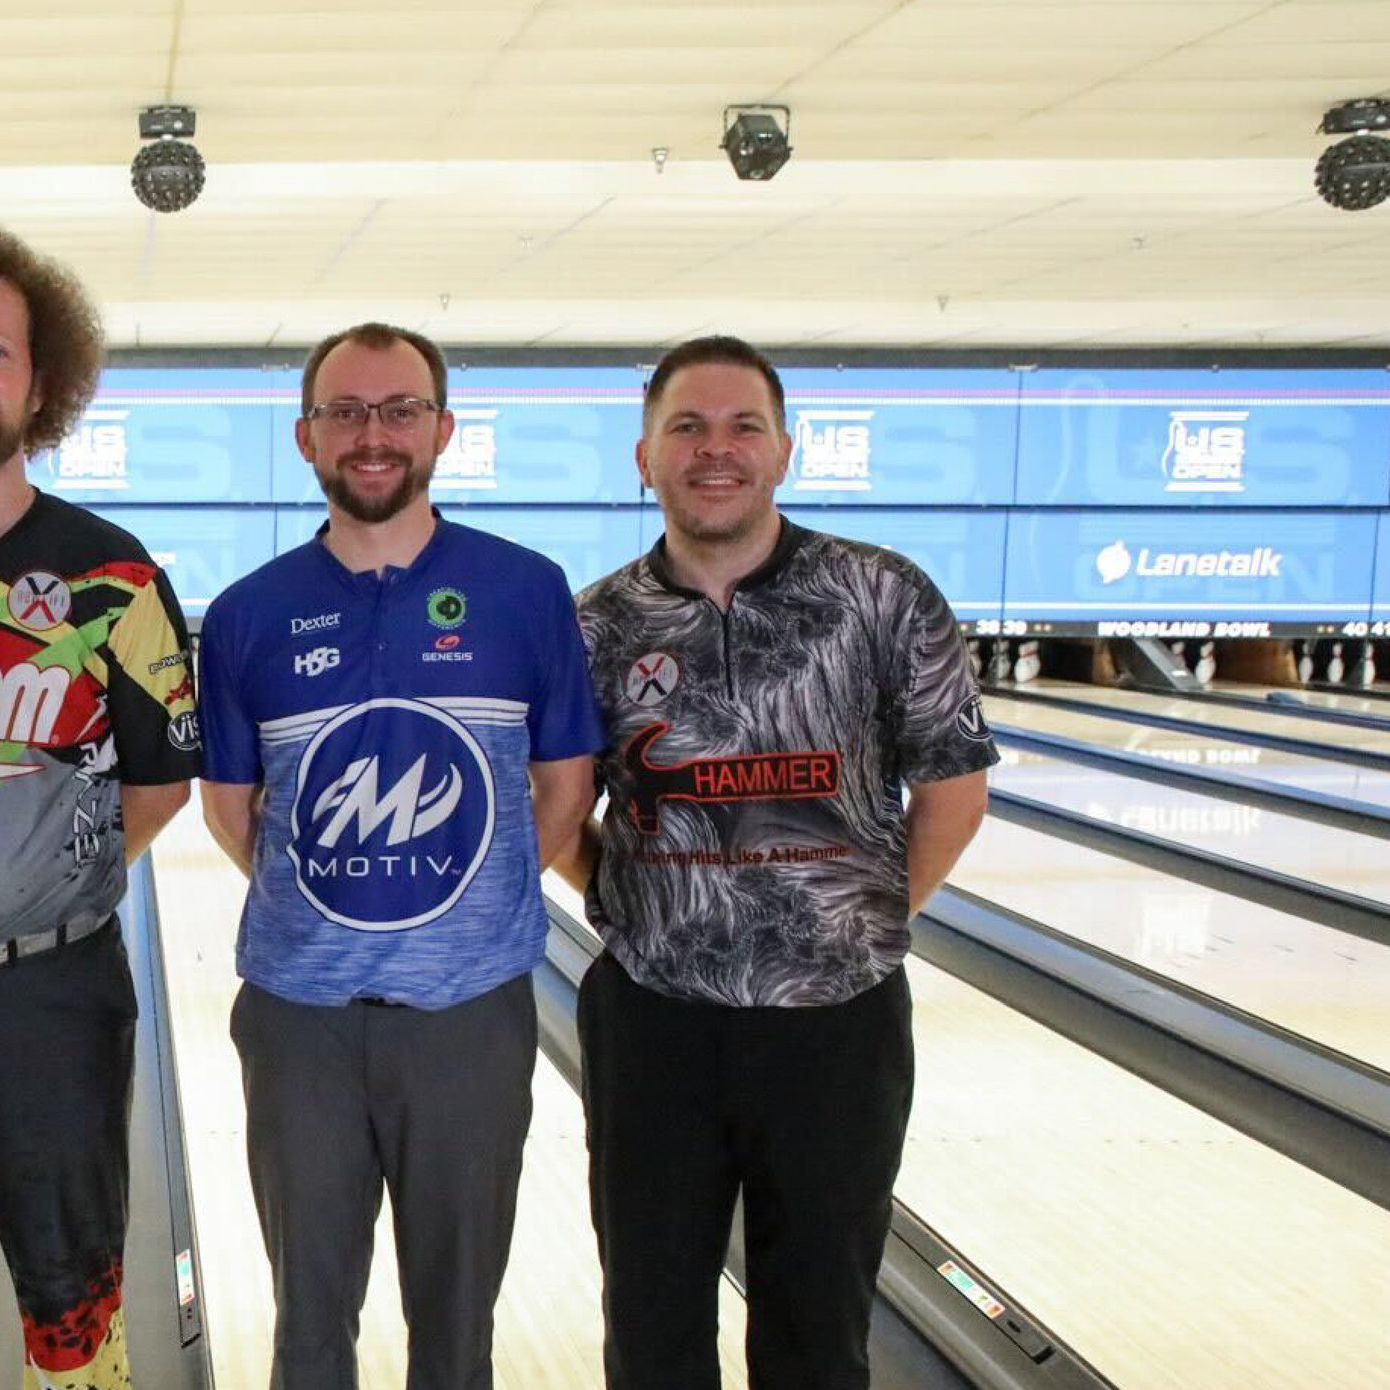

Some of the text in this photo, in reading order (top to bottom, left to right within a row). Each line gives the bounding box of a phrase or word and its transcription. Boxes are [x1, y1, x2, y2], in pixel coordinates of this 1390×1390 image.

[1135, 547, 1283, 576] Lanetalk
[290, 612, 341, 634] Dexter
[1097, 621, 1270, 637] WOODLAND BOWL
[421, 652, 473, 662] GENESIS
[693, 757, 833, 795] HAMMER
[308, 855, 453, 877] MOTIV
[725, 846, 764, 866] Like
[767, 846, 782, 864] A
[784, 844, 851, 864] Hamme
